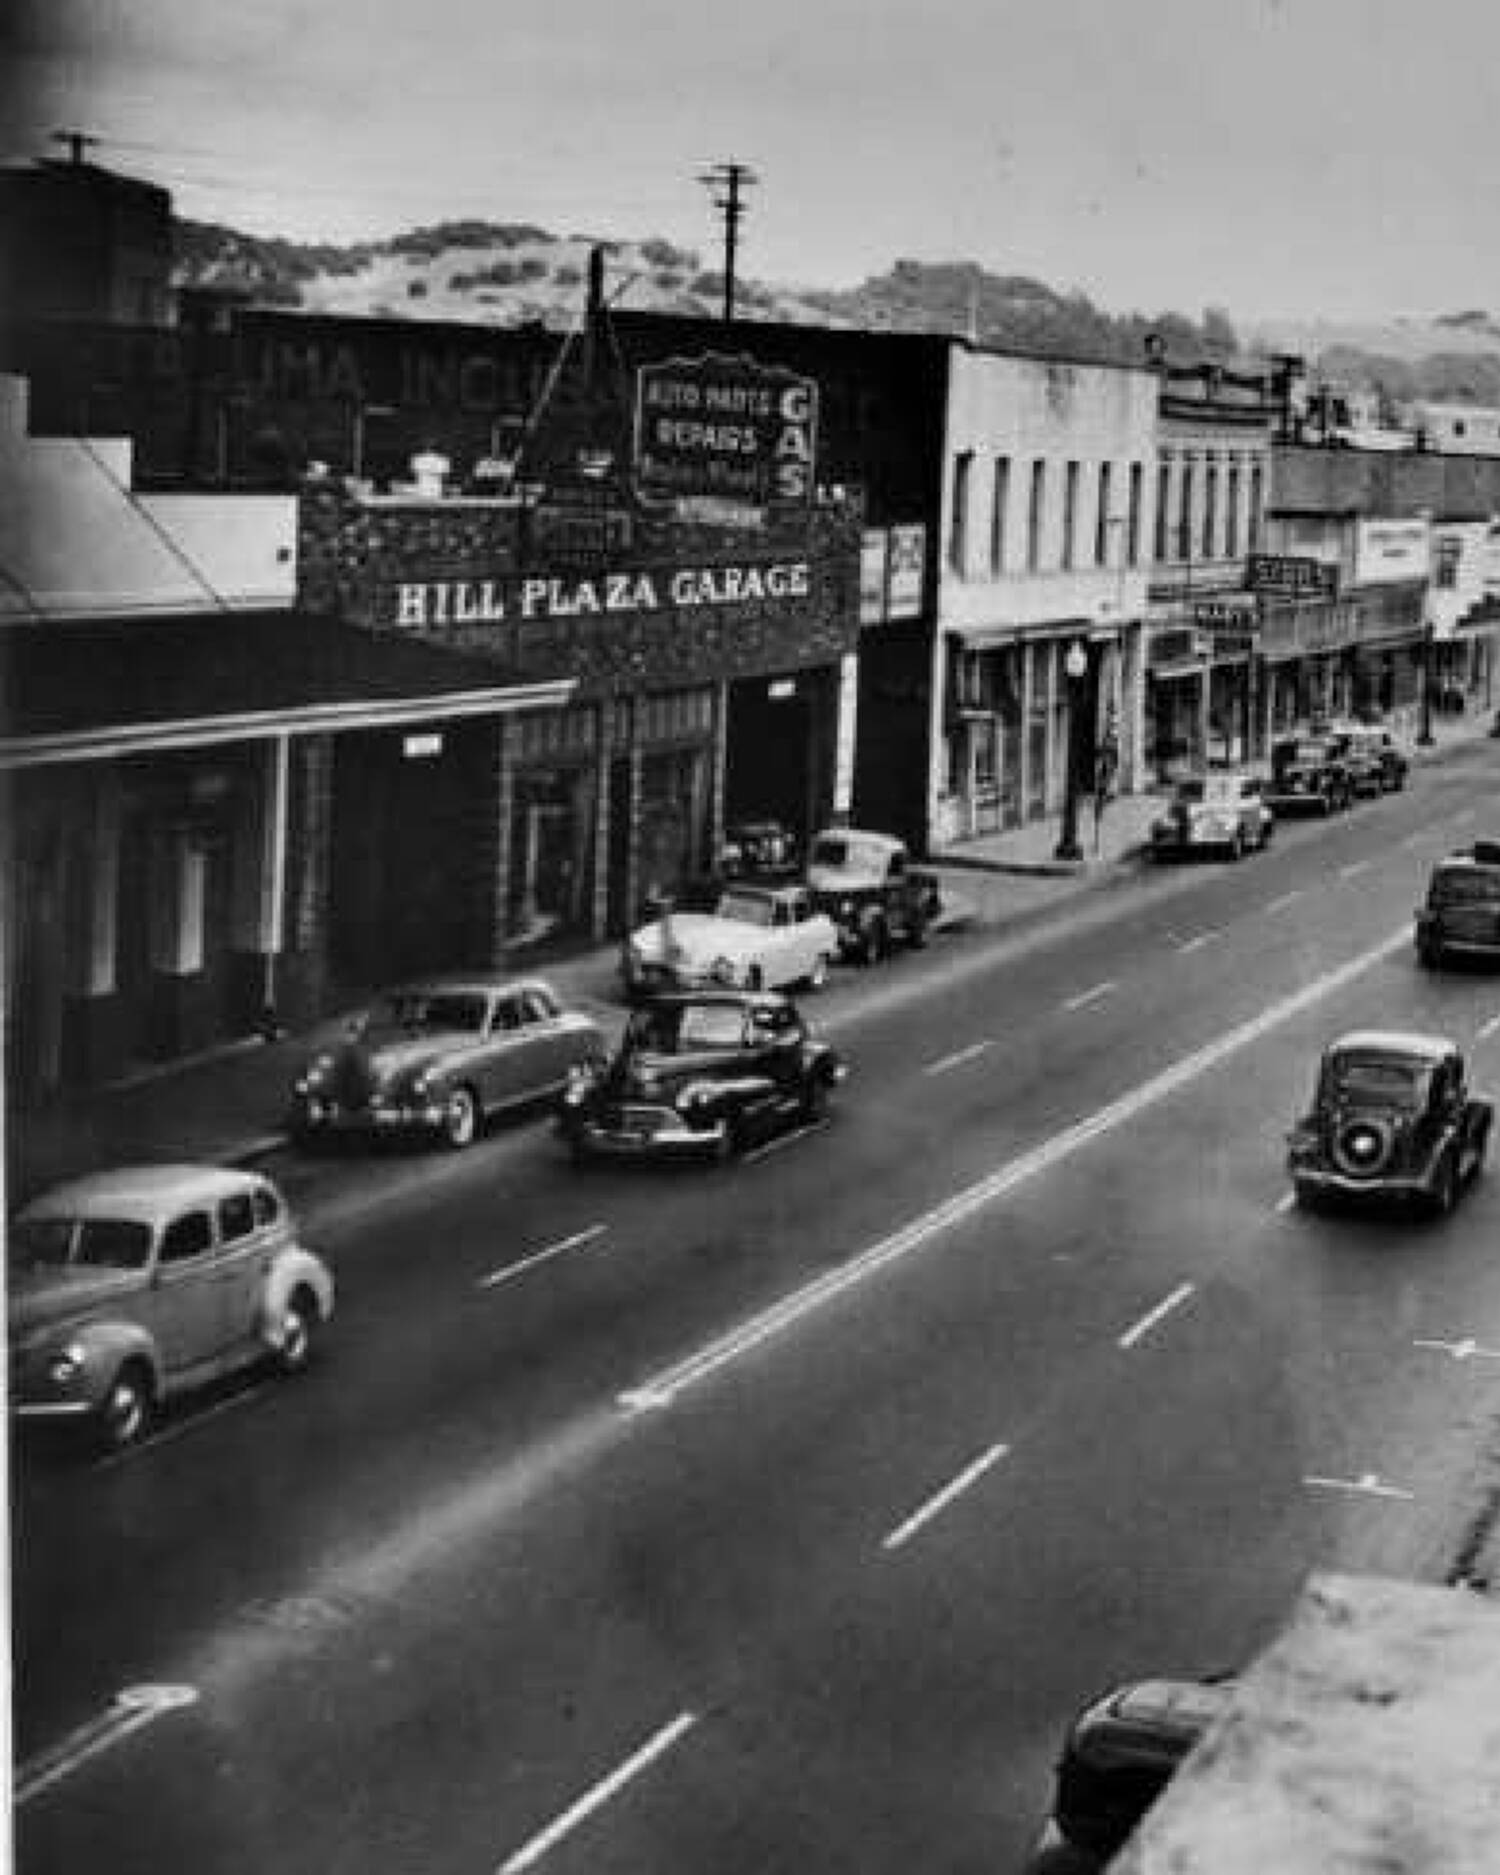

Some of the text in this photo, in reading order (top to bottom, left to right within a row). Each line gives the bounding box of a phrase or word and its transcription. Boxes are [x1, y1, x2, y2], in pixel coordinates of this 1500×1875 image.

[776, 386, 809, 497] GAS
[396, 563, 809, 627] HILL PLAZA GARAGE
